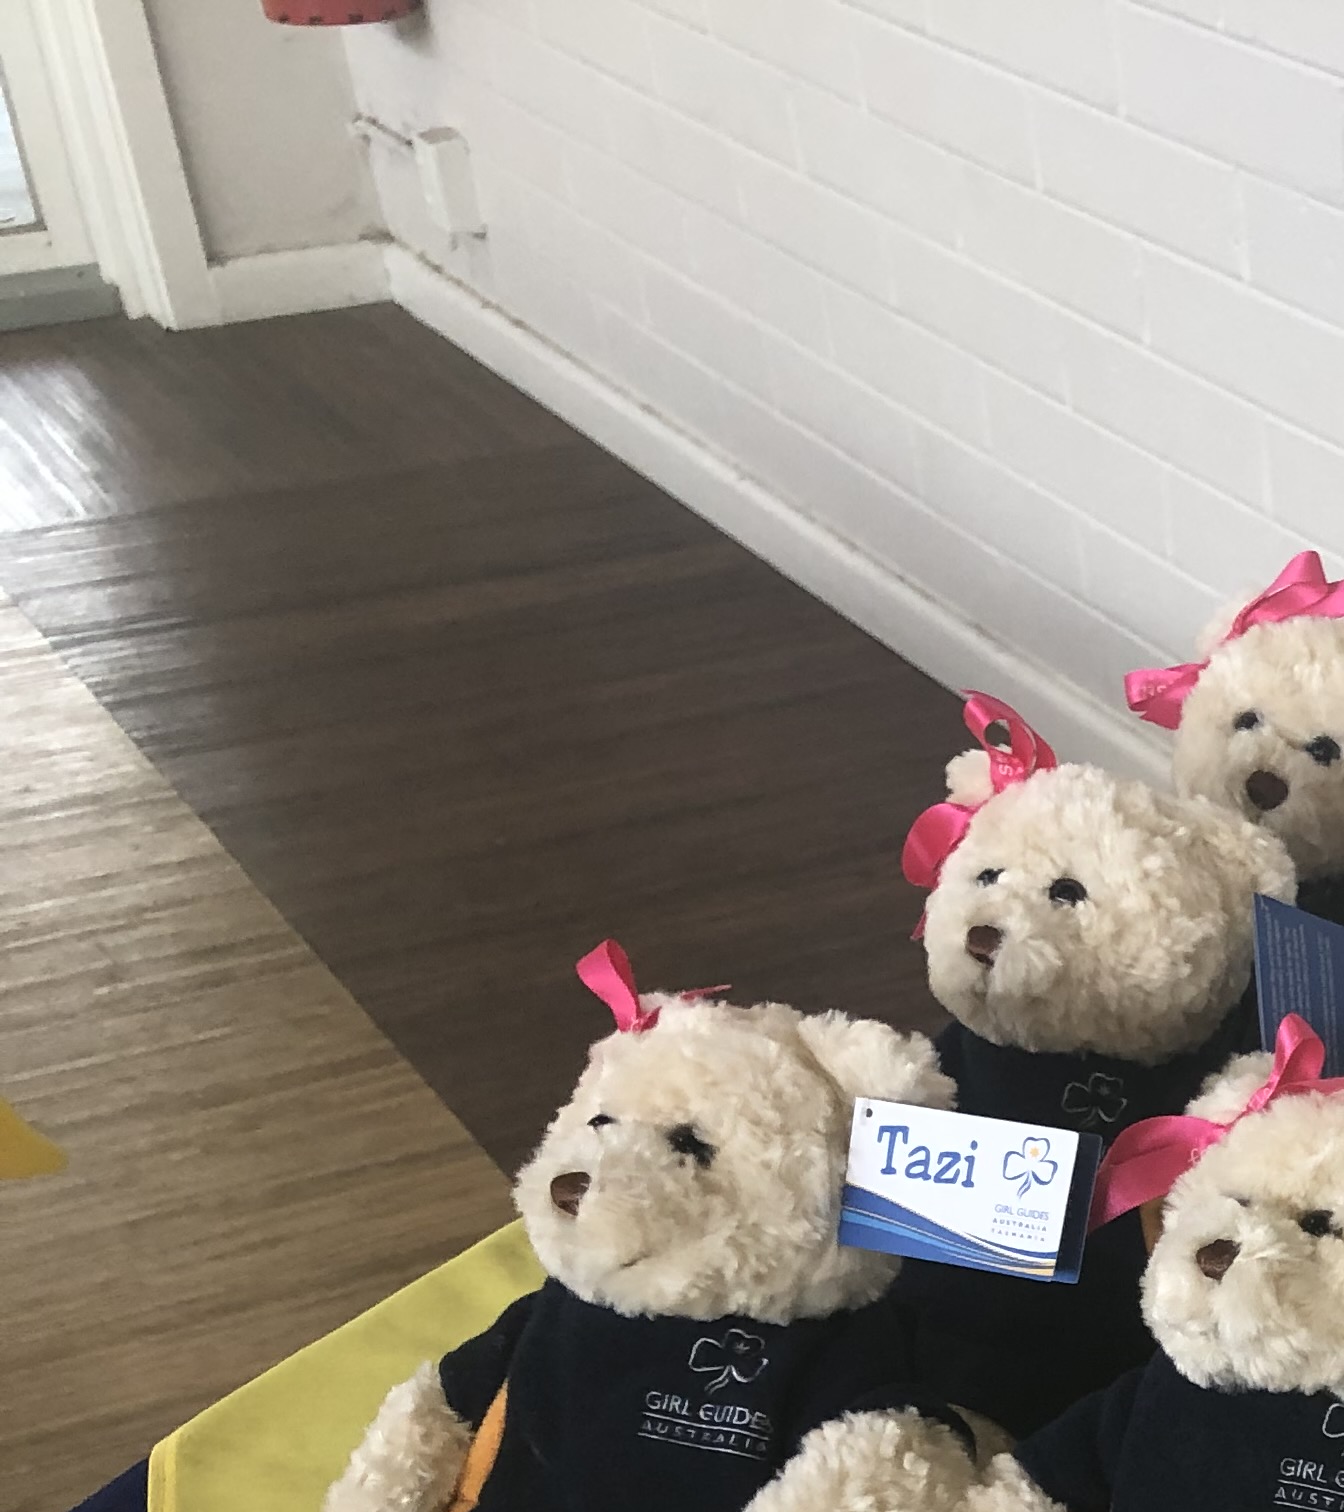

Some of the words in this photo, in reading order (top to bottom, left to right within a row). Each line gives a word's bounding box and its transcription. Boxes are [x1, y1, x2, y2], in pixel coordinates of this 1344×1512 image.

[876, 1125, 978, 1188] Tazi
[645, 1391, 690, 1416] GIRL
[1280, 1457, 1327, 1484] GIRL
